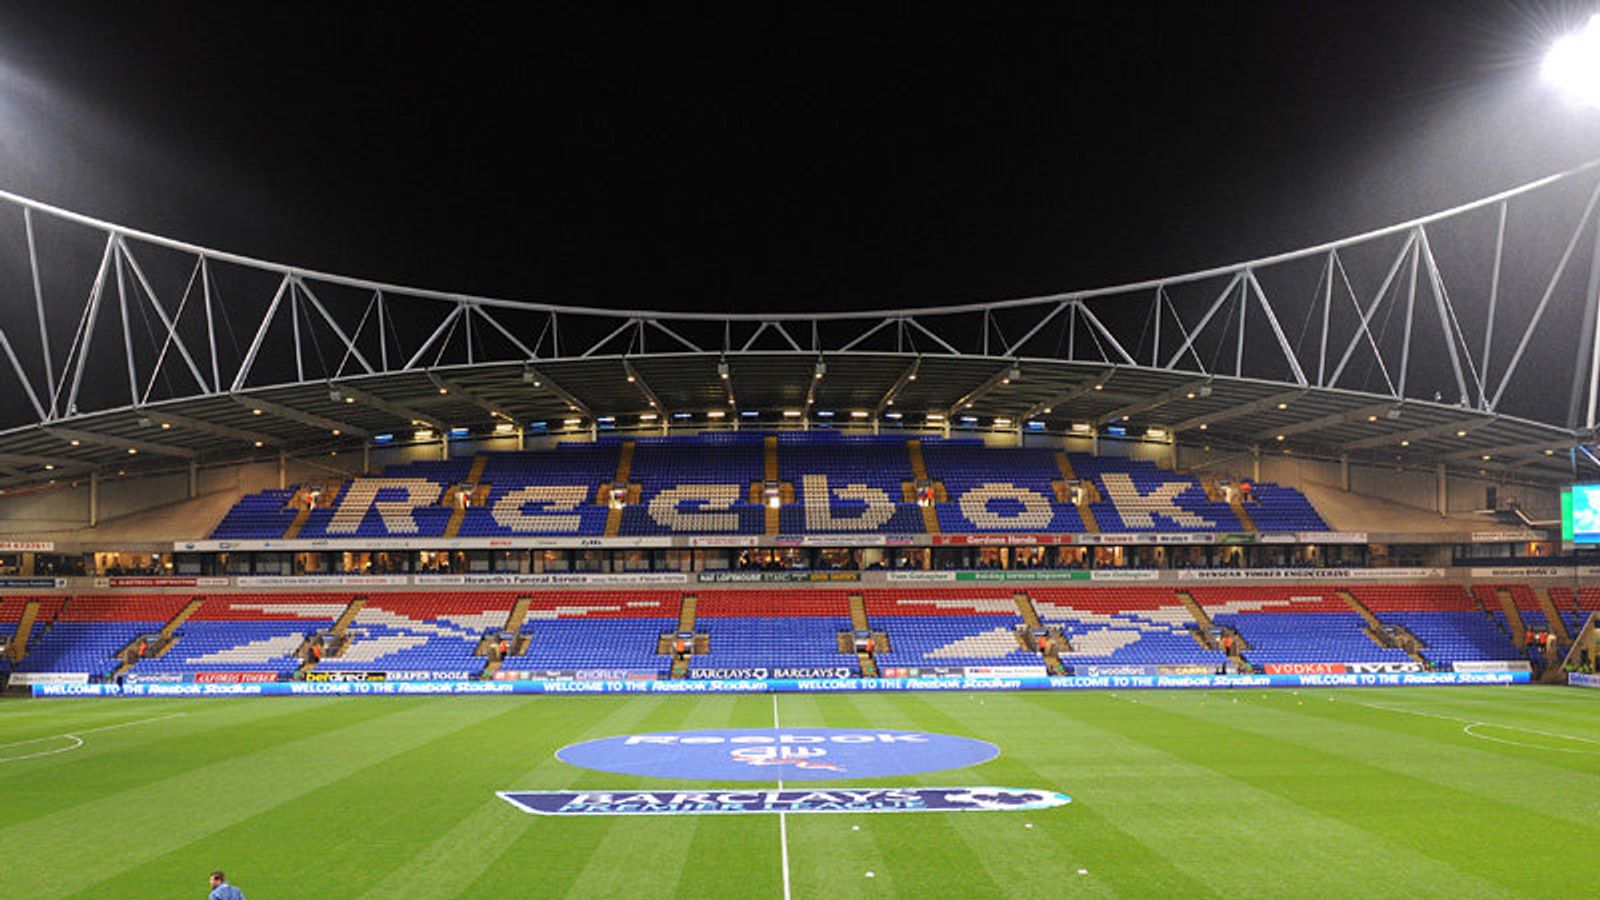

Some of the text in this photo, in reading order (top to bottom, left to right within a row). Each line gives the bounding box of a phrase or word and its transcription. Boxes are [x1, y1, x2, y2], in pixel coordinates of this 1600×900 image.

[326, 473, 1217, 535] Reebok
[774, 668, 833, 677] BARCLAYS
[1273, 664, 1333, 672] VODKAT
[692, 669, 752, 678] BARCLAYS
[1298, 673, 1513, 684] WELCOME TO THE Reebok Stadium
[544, 681, 768, 691] WELCOME TO THE Reebok Stadium
[798, 680, 1021, 689] WELCOME TO THE Reebok Stadium
[1050, 677, 1270, 687] WELCOME TO THE Reebok Stadium
[44, 684, 261, 694] WELCOME TO THE Reebok Stadium
[291, 683, 513, 693] WELCOME TO THE Reebok Stadium
[624, 734, 929, 745] Reebok
[569, 791, 922, 805] BARCLAYS
[558, 801, 928, 812] PREMIER LEAGUE
